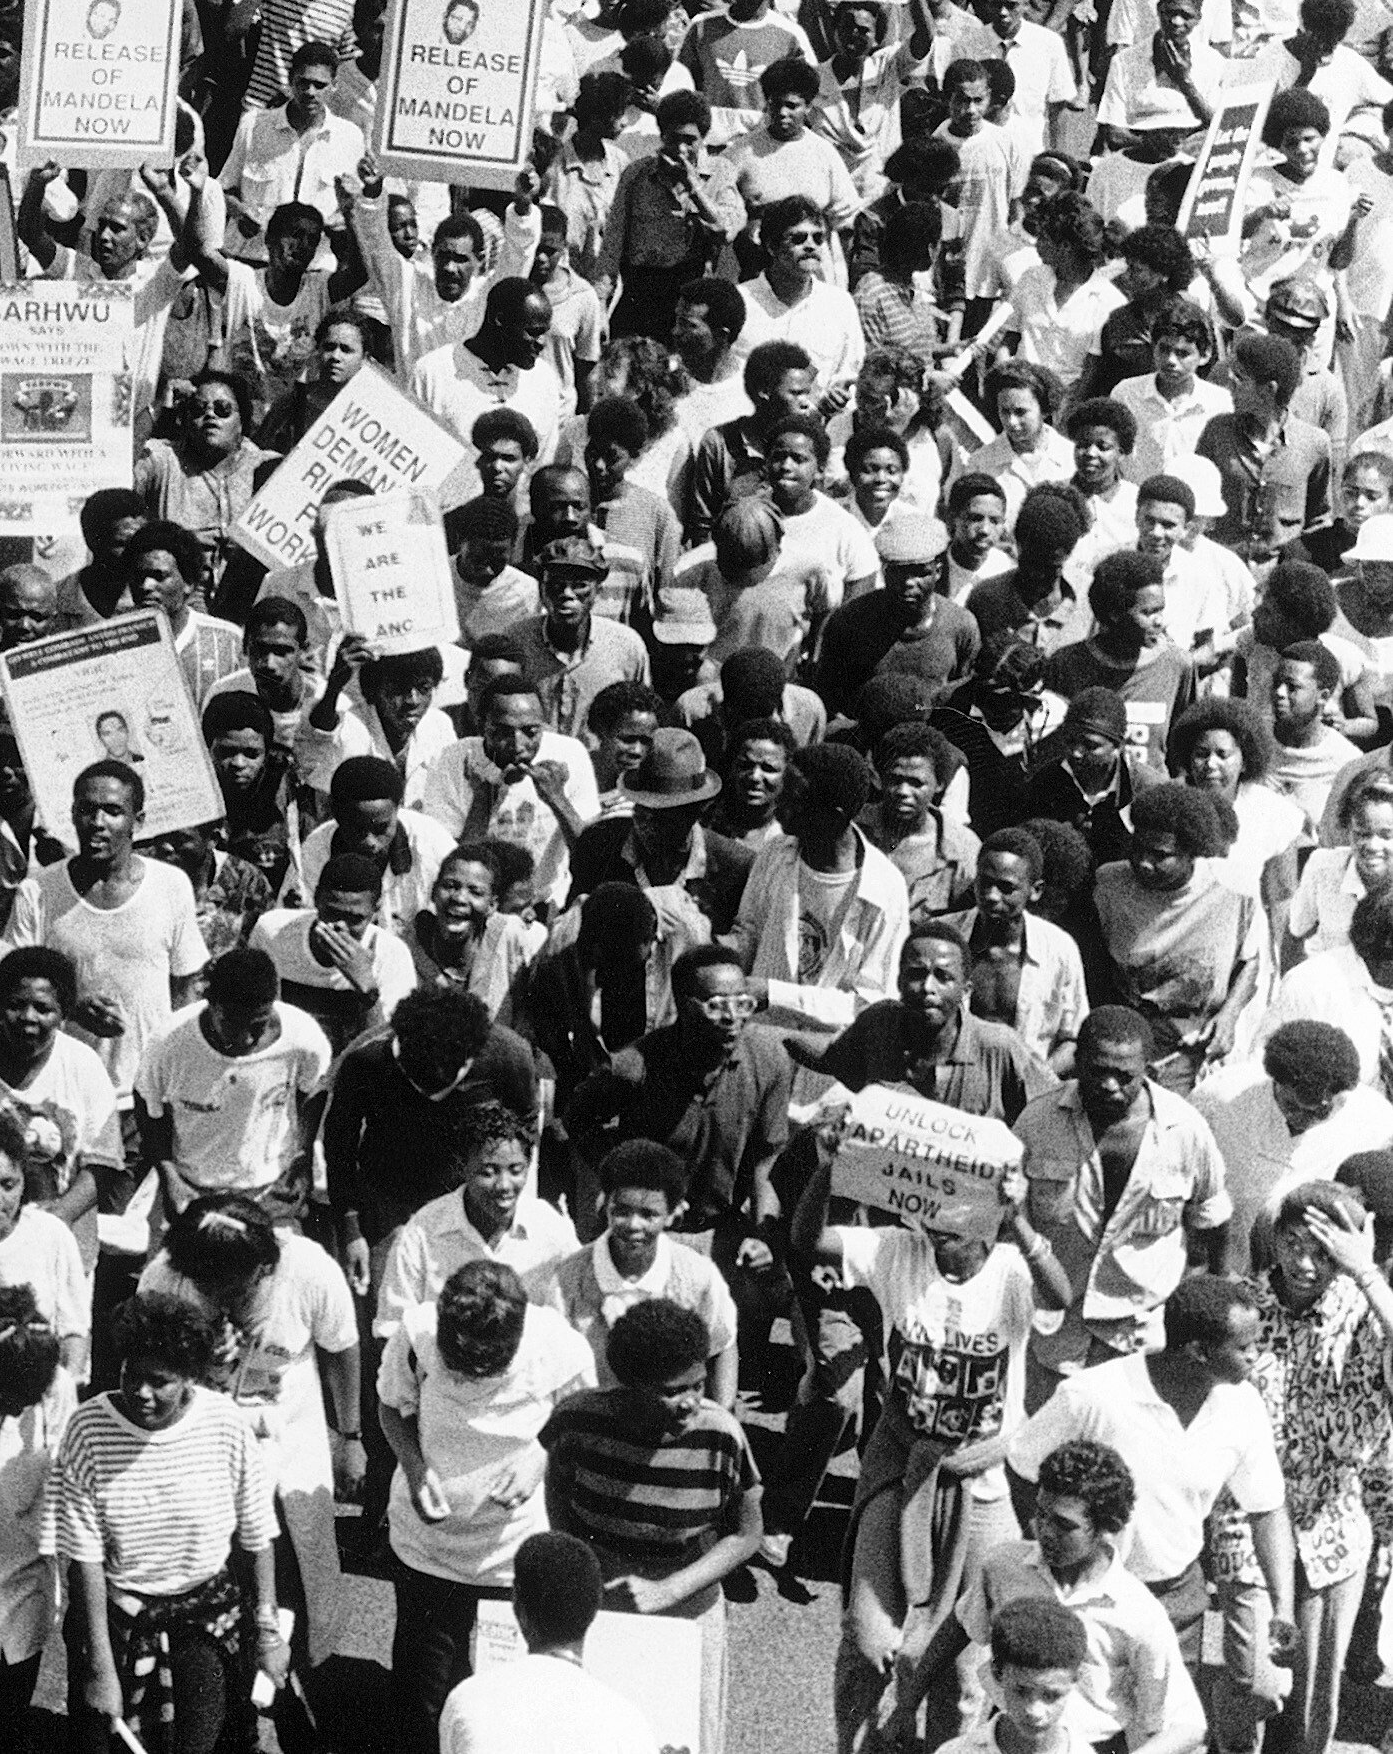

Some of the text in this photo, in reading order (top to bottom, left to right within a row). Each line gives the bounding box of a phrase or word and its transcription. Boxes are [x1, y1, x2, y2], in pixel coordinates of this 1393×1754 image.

[54, 42, 164, 63] RELEASE
[410, 44, 522, 75] RELEASE
[91, 67, 123, 86] OF
[446, 75, 480, 96] OF
[43, 90, 159, 112] MANDELA
[397, 97, 516, 127] MANDELA
[74, 116, 132, 135] NOW
[428, 127, 487, 151] NOW
[28, 324, 67, 336] SAYS
[340, 399, 428, 484] WOMEN
[312, 423, 397, 496] DEMAN
[356, 519, 388, 537] WE
[364, 552, 402, 571] ARE
[369, 585, 407, 604] THE
[375, 618, 415, 638] ANC
[884, 1103, 977, 1146] UNLOCK
[851, 1122, 996, 1181] APARTHEID
[881, 1161, 957, 1197] JAILS
[887, 1188, 942, 1220] NOW
[944, 1325, 999, 1354] LIVES
